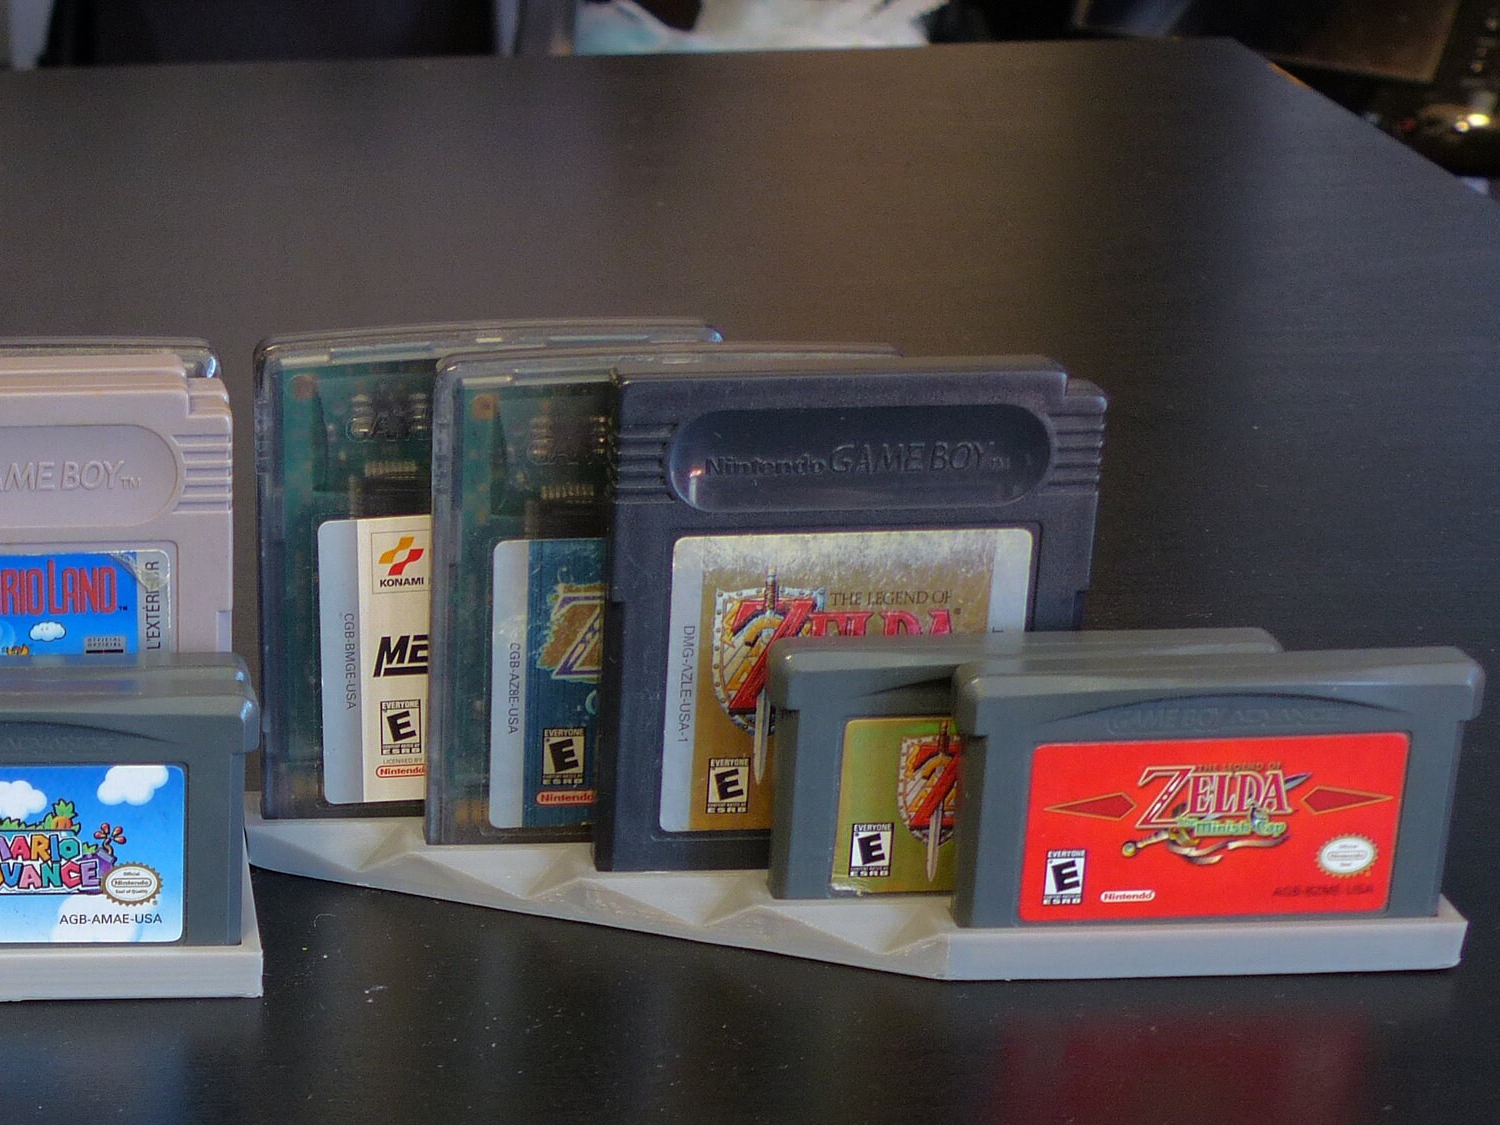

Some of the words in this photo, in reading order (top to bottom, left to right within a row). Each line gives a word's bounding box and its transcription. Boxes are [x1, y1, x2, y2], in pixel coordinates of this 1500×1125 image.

[705, 452, 826, 476] Nintendo
[829, 442, 925, 474] GAME
[929, 440, 995, 471] BOY
[60, 459, 124, 491] BOY
[379, 577, 425, 588] KONAMI
[830, 592, 861, 606] THE
[867, 590, 929, 606] LEGEND
[142, 561, 161, 650] L'EXTÉRIR
[344, 613, 357, 710] CGB-BMGE-USA
[382, 701, 420, 710] EVERYONE
[387, 710, 417, 743] E
[544, 728, 584, 737] EVERYONE
[549, 738, 579, 773] E
[711, 758, 749, 767] EVERYONE
[715, 768, 744, 801] E
[1135, 765, 1293, 829] ZELDA
[853, 823, 892, 832] EVERYONE
[1197, 820, 1253, 836] Minish
[1256, 820, 1286, 837] Cap
[858, 833, 886, 865] E
[1051, 859, 1080, 893] E
[1103, 890, 1153, 901] Nintendo
[59, 913, 162, 925] AGB-AMAE-USA
